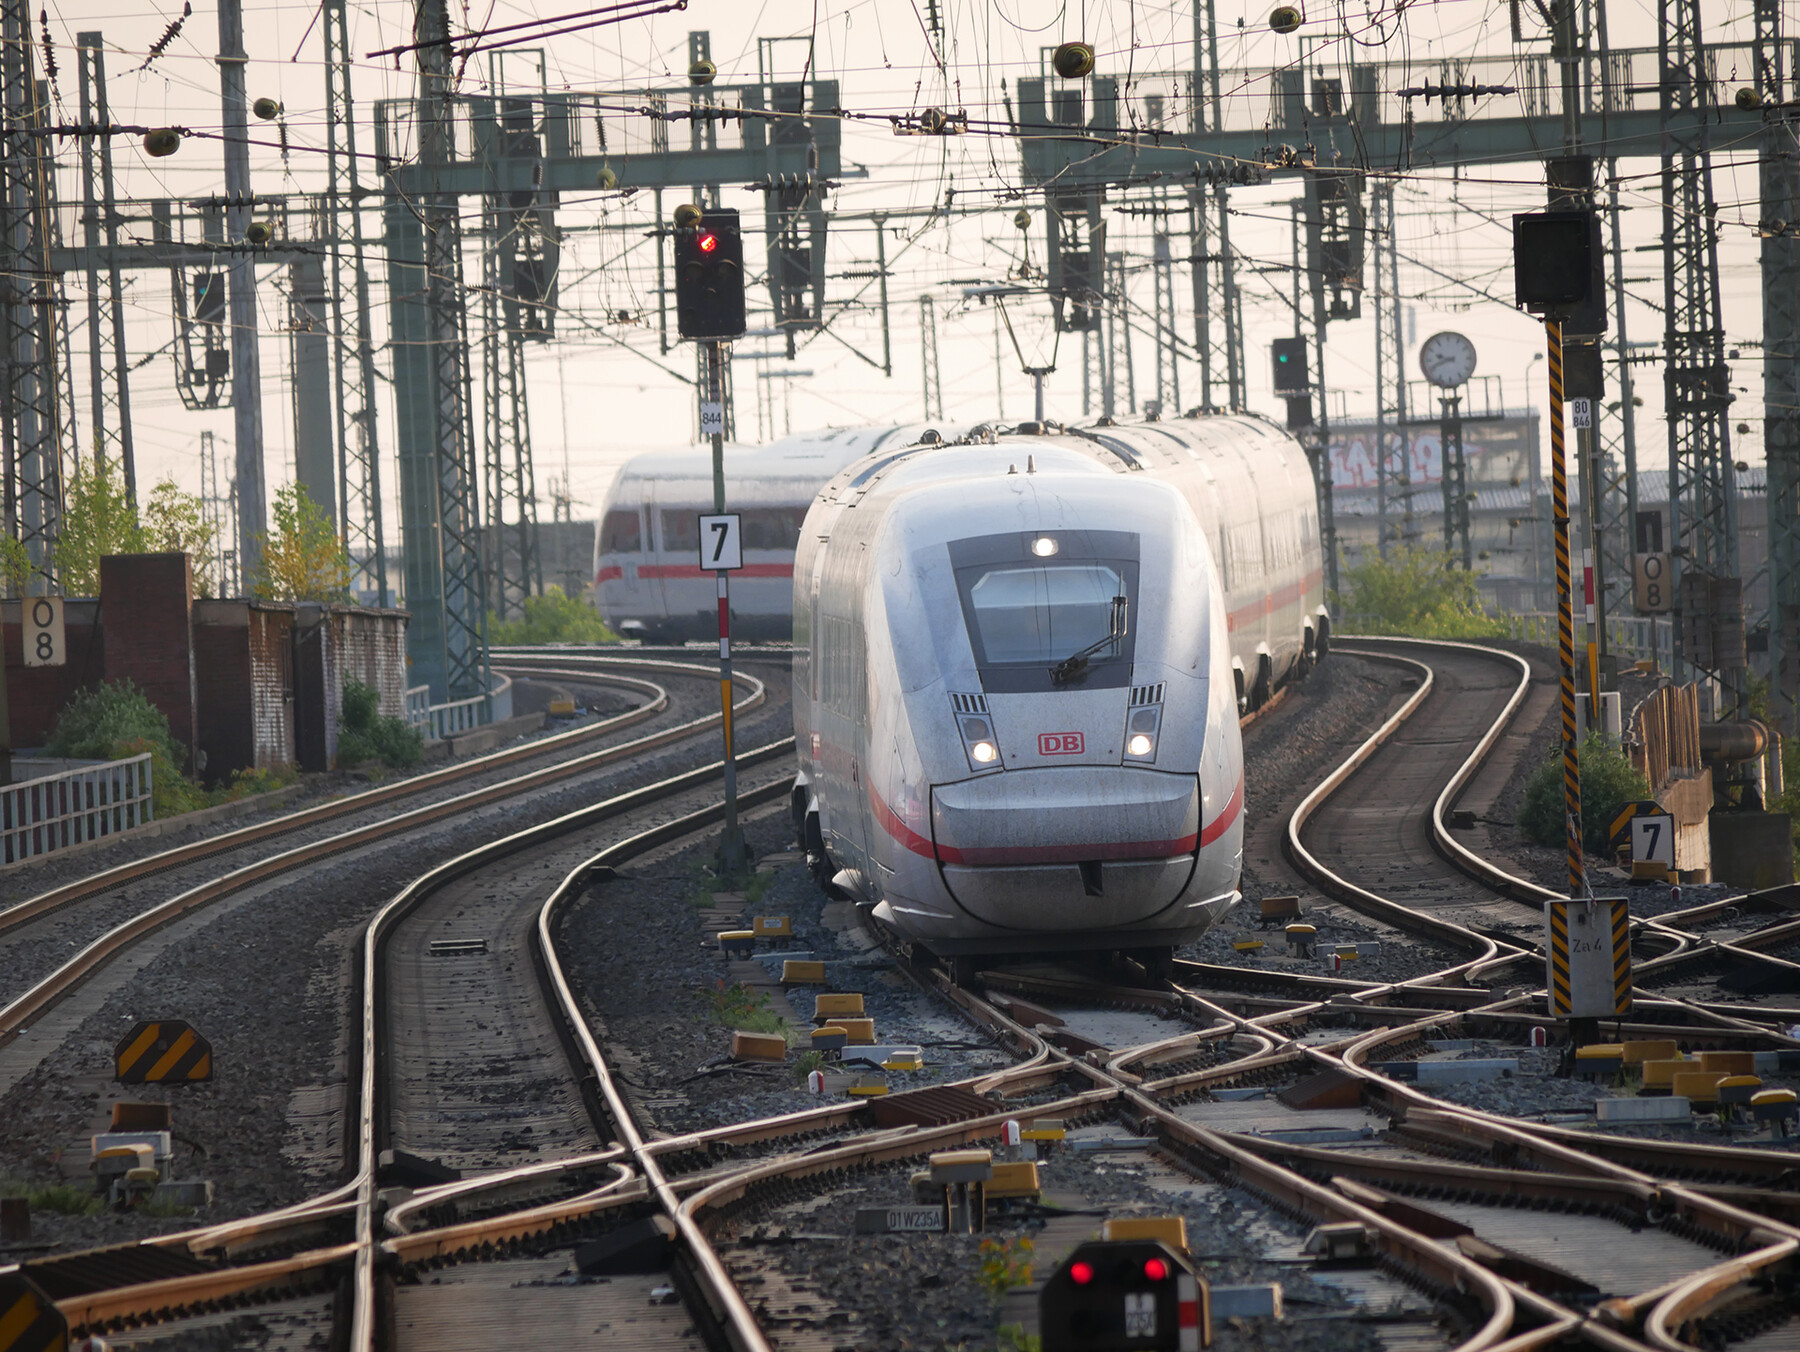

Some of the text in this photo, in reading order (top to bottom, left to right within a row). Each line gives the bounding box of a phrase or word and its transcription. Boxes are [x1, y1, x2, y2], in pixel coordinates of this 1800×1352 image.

[702, 412, 721, 425] 844
[1575, 401, 1588, 414] 80
[1573, 416, 1590, 427] 846
[711, 523, 728, 561] 7
[1644, 556, 1661, 580] 0
[1647, 583, 1660, 607] 8
[33, 600, 53, 628] 0
[36, 632, 53, 660] 8
[1042, 734, 1081, 753] DB
[1643, 823, 1661, 860] 7
